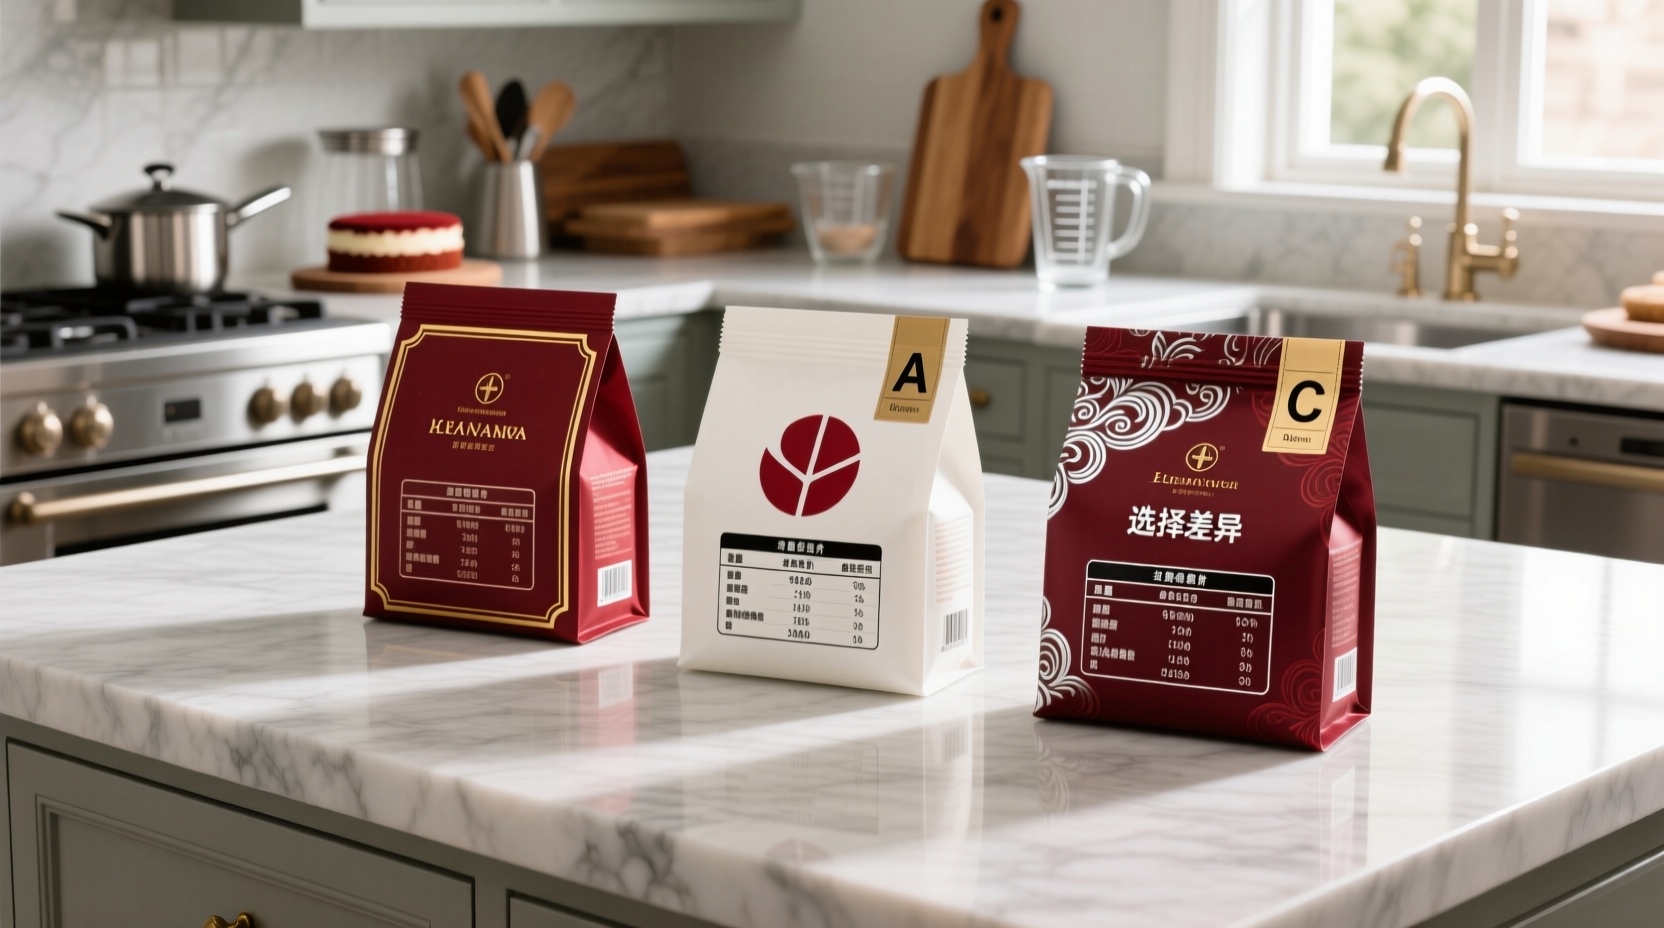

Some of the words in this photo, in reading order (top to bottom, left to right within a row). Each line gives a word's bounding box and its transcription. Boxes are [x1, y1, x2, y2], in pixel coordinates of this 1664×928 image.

[892, 352, 927, 393] A
[1287, 380, 1325, 423] C
[1127, 504, 1242, 543] 选择差异
